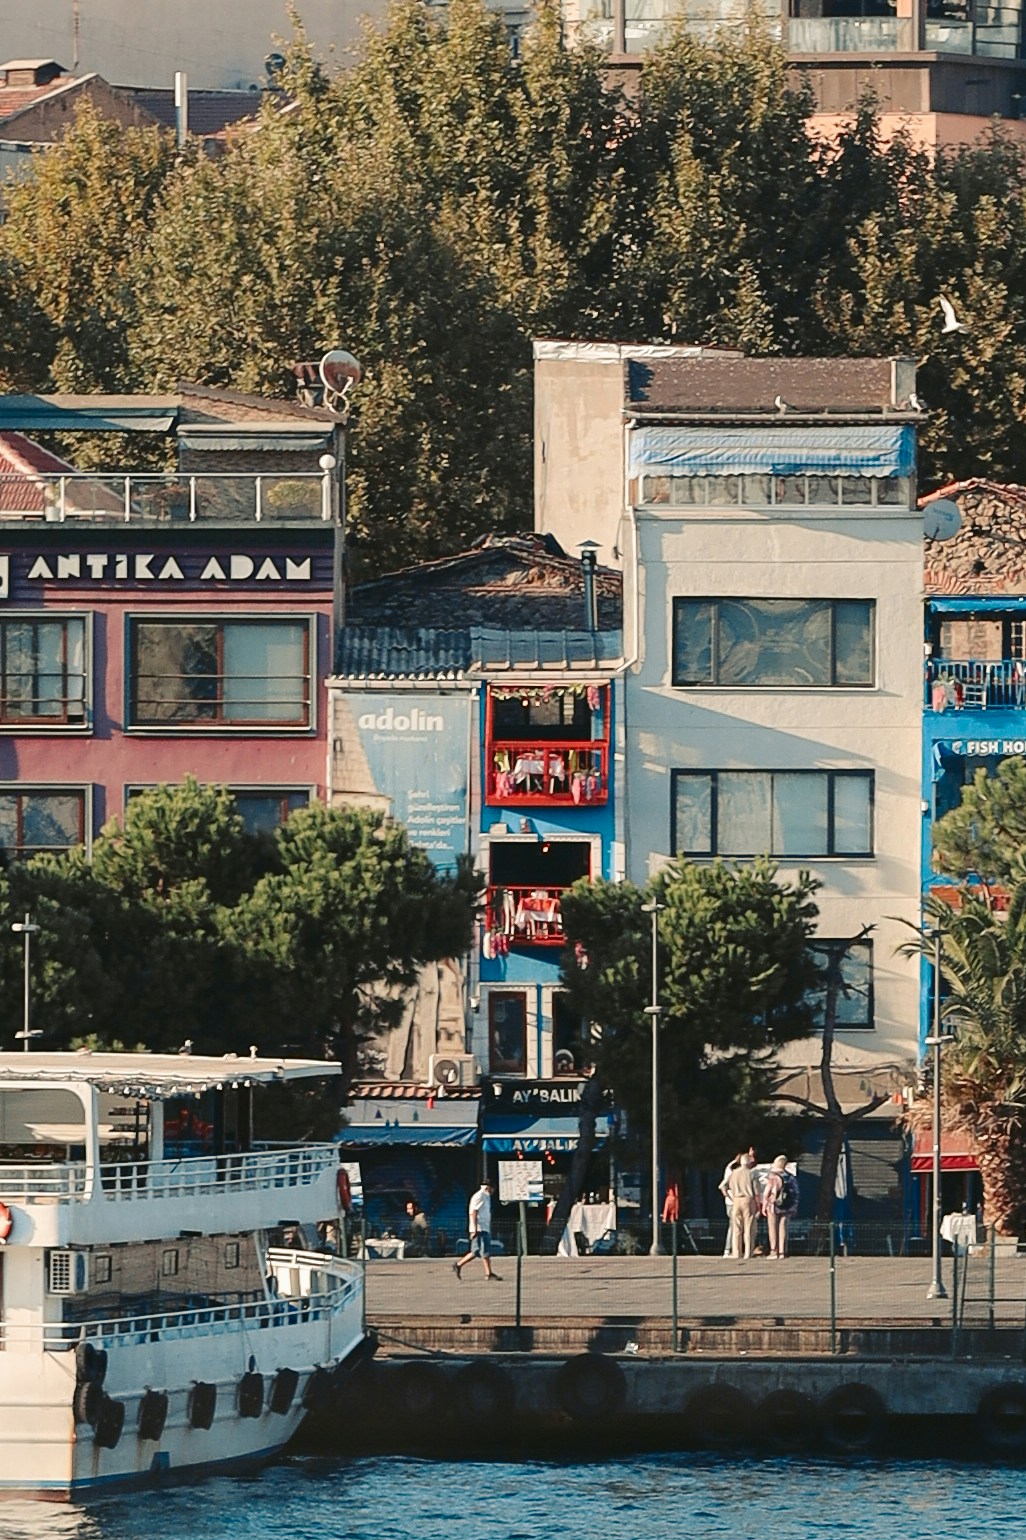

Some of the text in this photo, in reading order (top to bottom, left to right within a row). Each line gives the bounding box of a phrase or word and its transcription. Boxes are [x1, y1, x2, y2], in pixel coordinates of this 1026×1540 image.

[200, 554, 311, 580] ADAM
[358, 707, 444, 731] adolin
[966, 741, 998, 754] FISH
